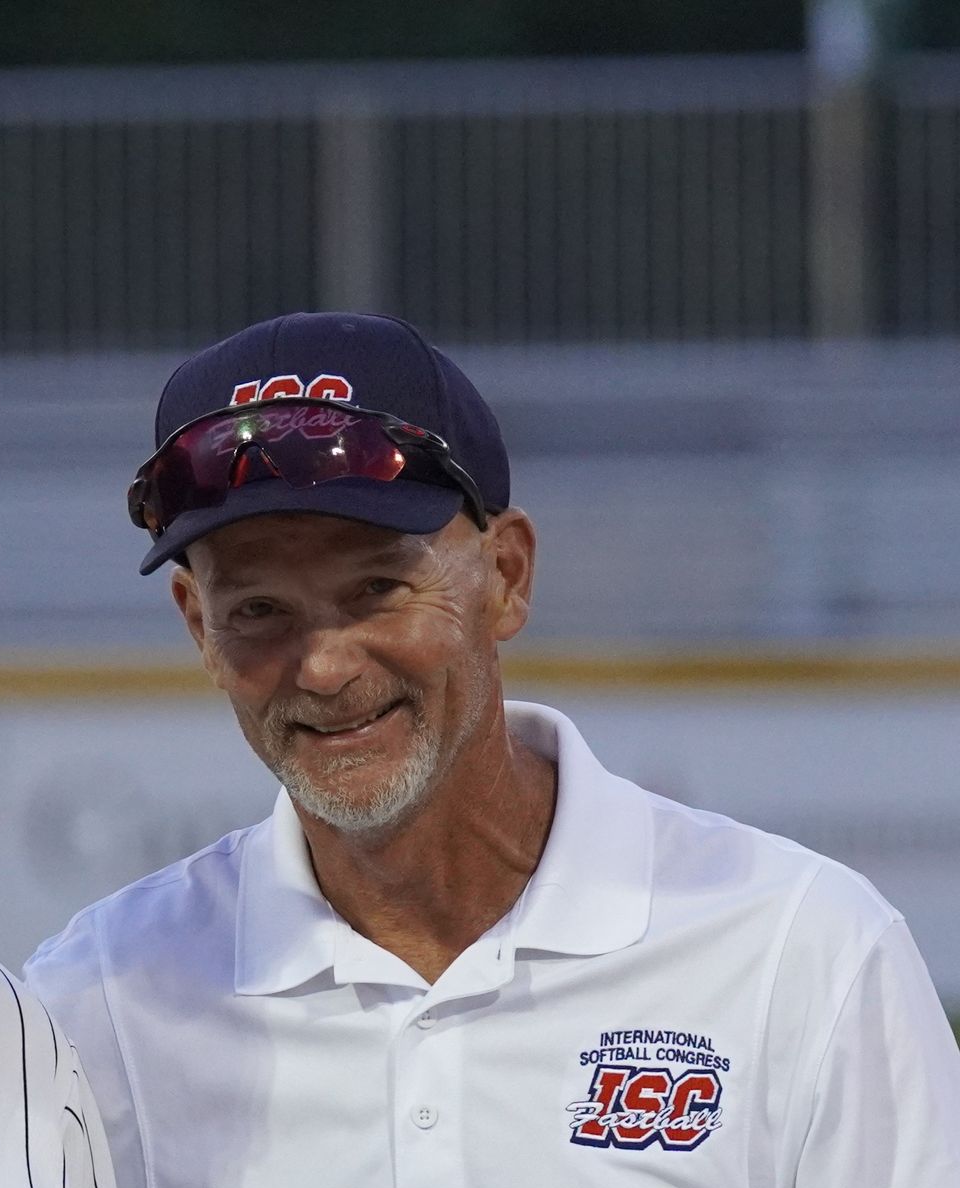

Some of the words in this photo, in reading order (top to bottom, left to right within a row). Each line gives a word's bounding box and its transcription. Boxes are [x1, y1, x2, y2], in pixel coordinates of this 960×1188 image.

[599, 1029, 716, 1053] INTERNATIONAL
[579, 1046, 651, 1067] SOFTBALL
[655, 1048, 731, 1073] CONGRESS
[565, 1096, 724, 1132] Fastball
[570, 1064, 723, 1152] ISC
